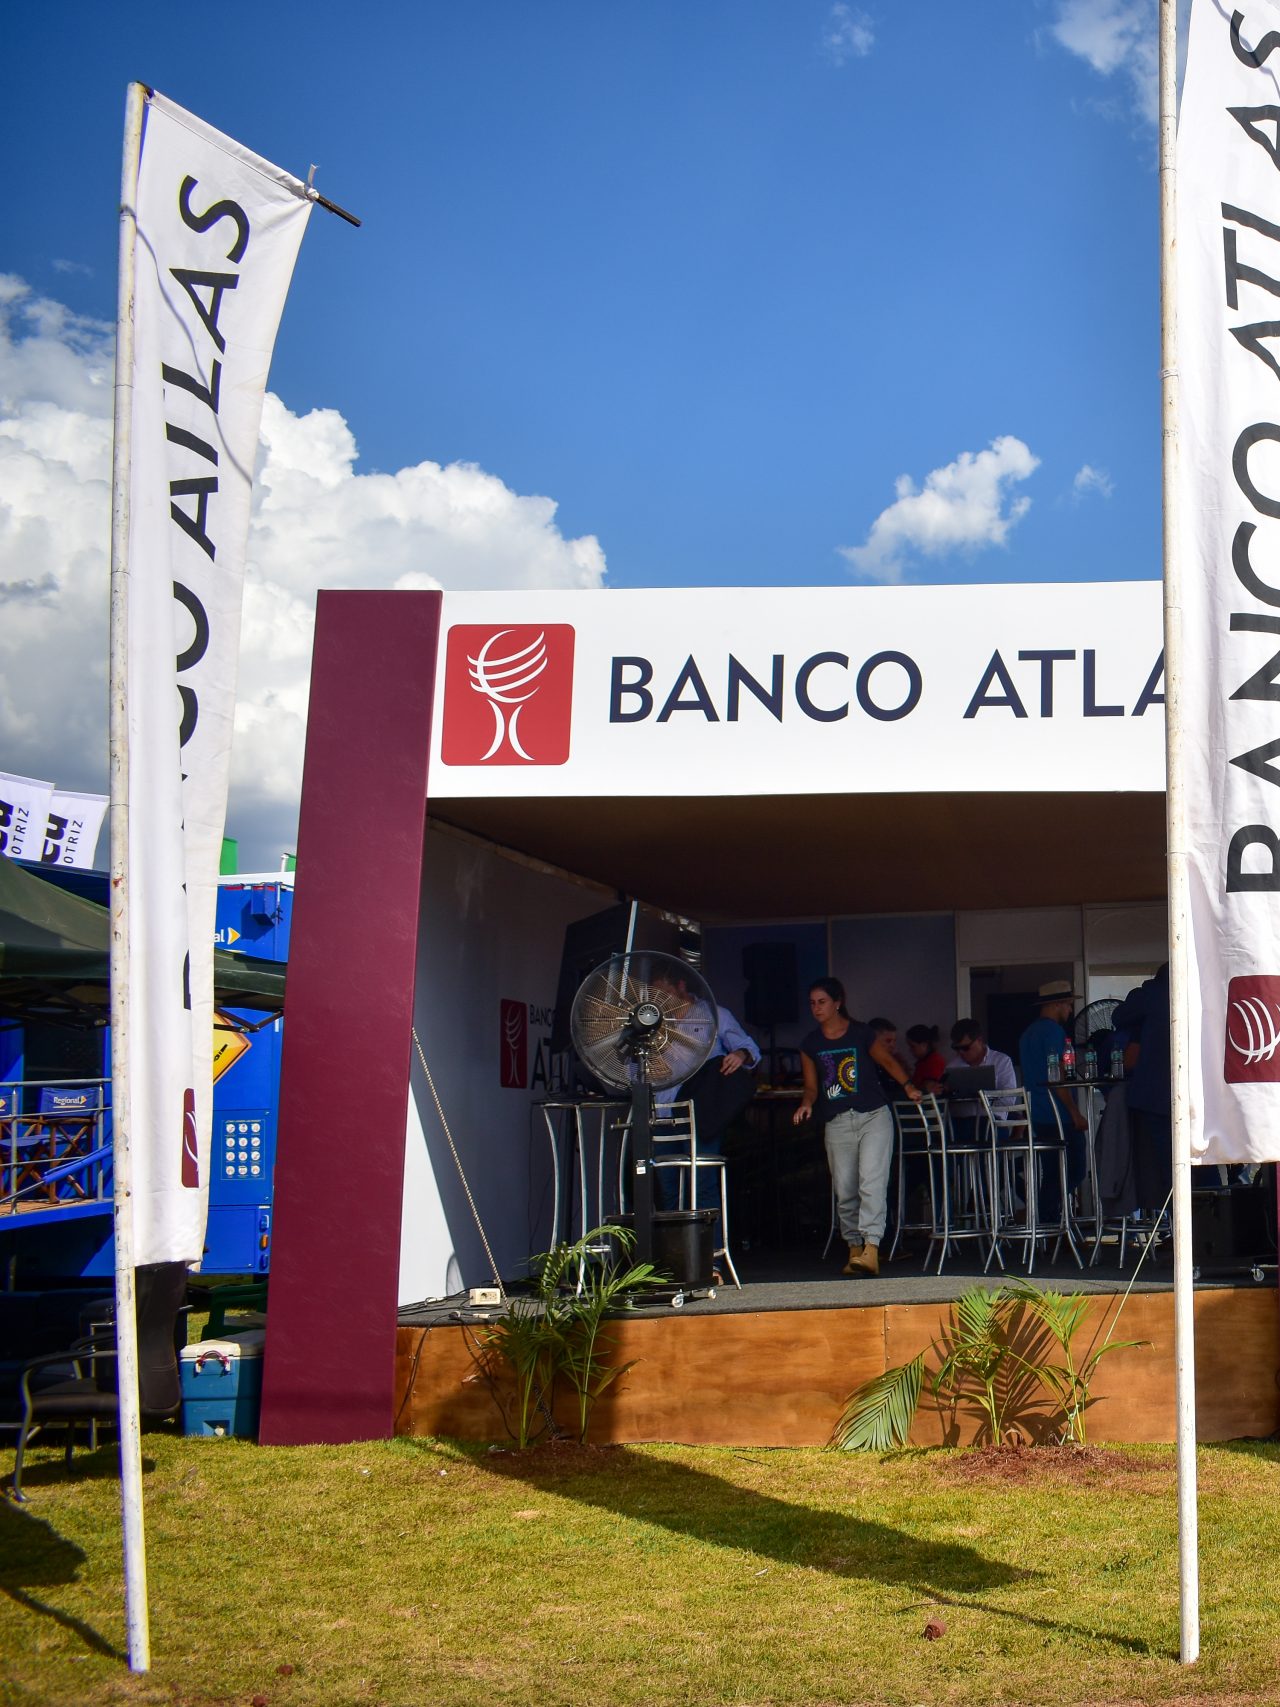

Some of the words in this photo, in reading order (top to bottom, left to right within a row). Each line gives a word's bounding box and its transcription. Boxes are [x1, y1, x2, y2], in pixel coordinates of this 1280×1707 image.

[608, 650, 922, 723] BANCO
[962, 648, 1165, 718] ATLA
[11, 807, 29, 855] OTRIZ
[63, 819, 83, 864] OTRIZ
[530, 1003, 555, 1027] BANC
[53, 1096, 80, 1105] Regional
